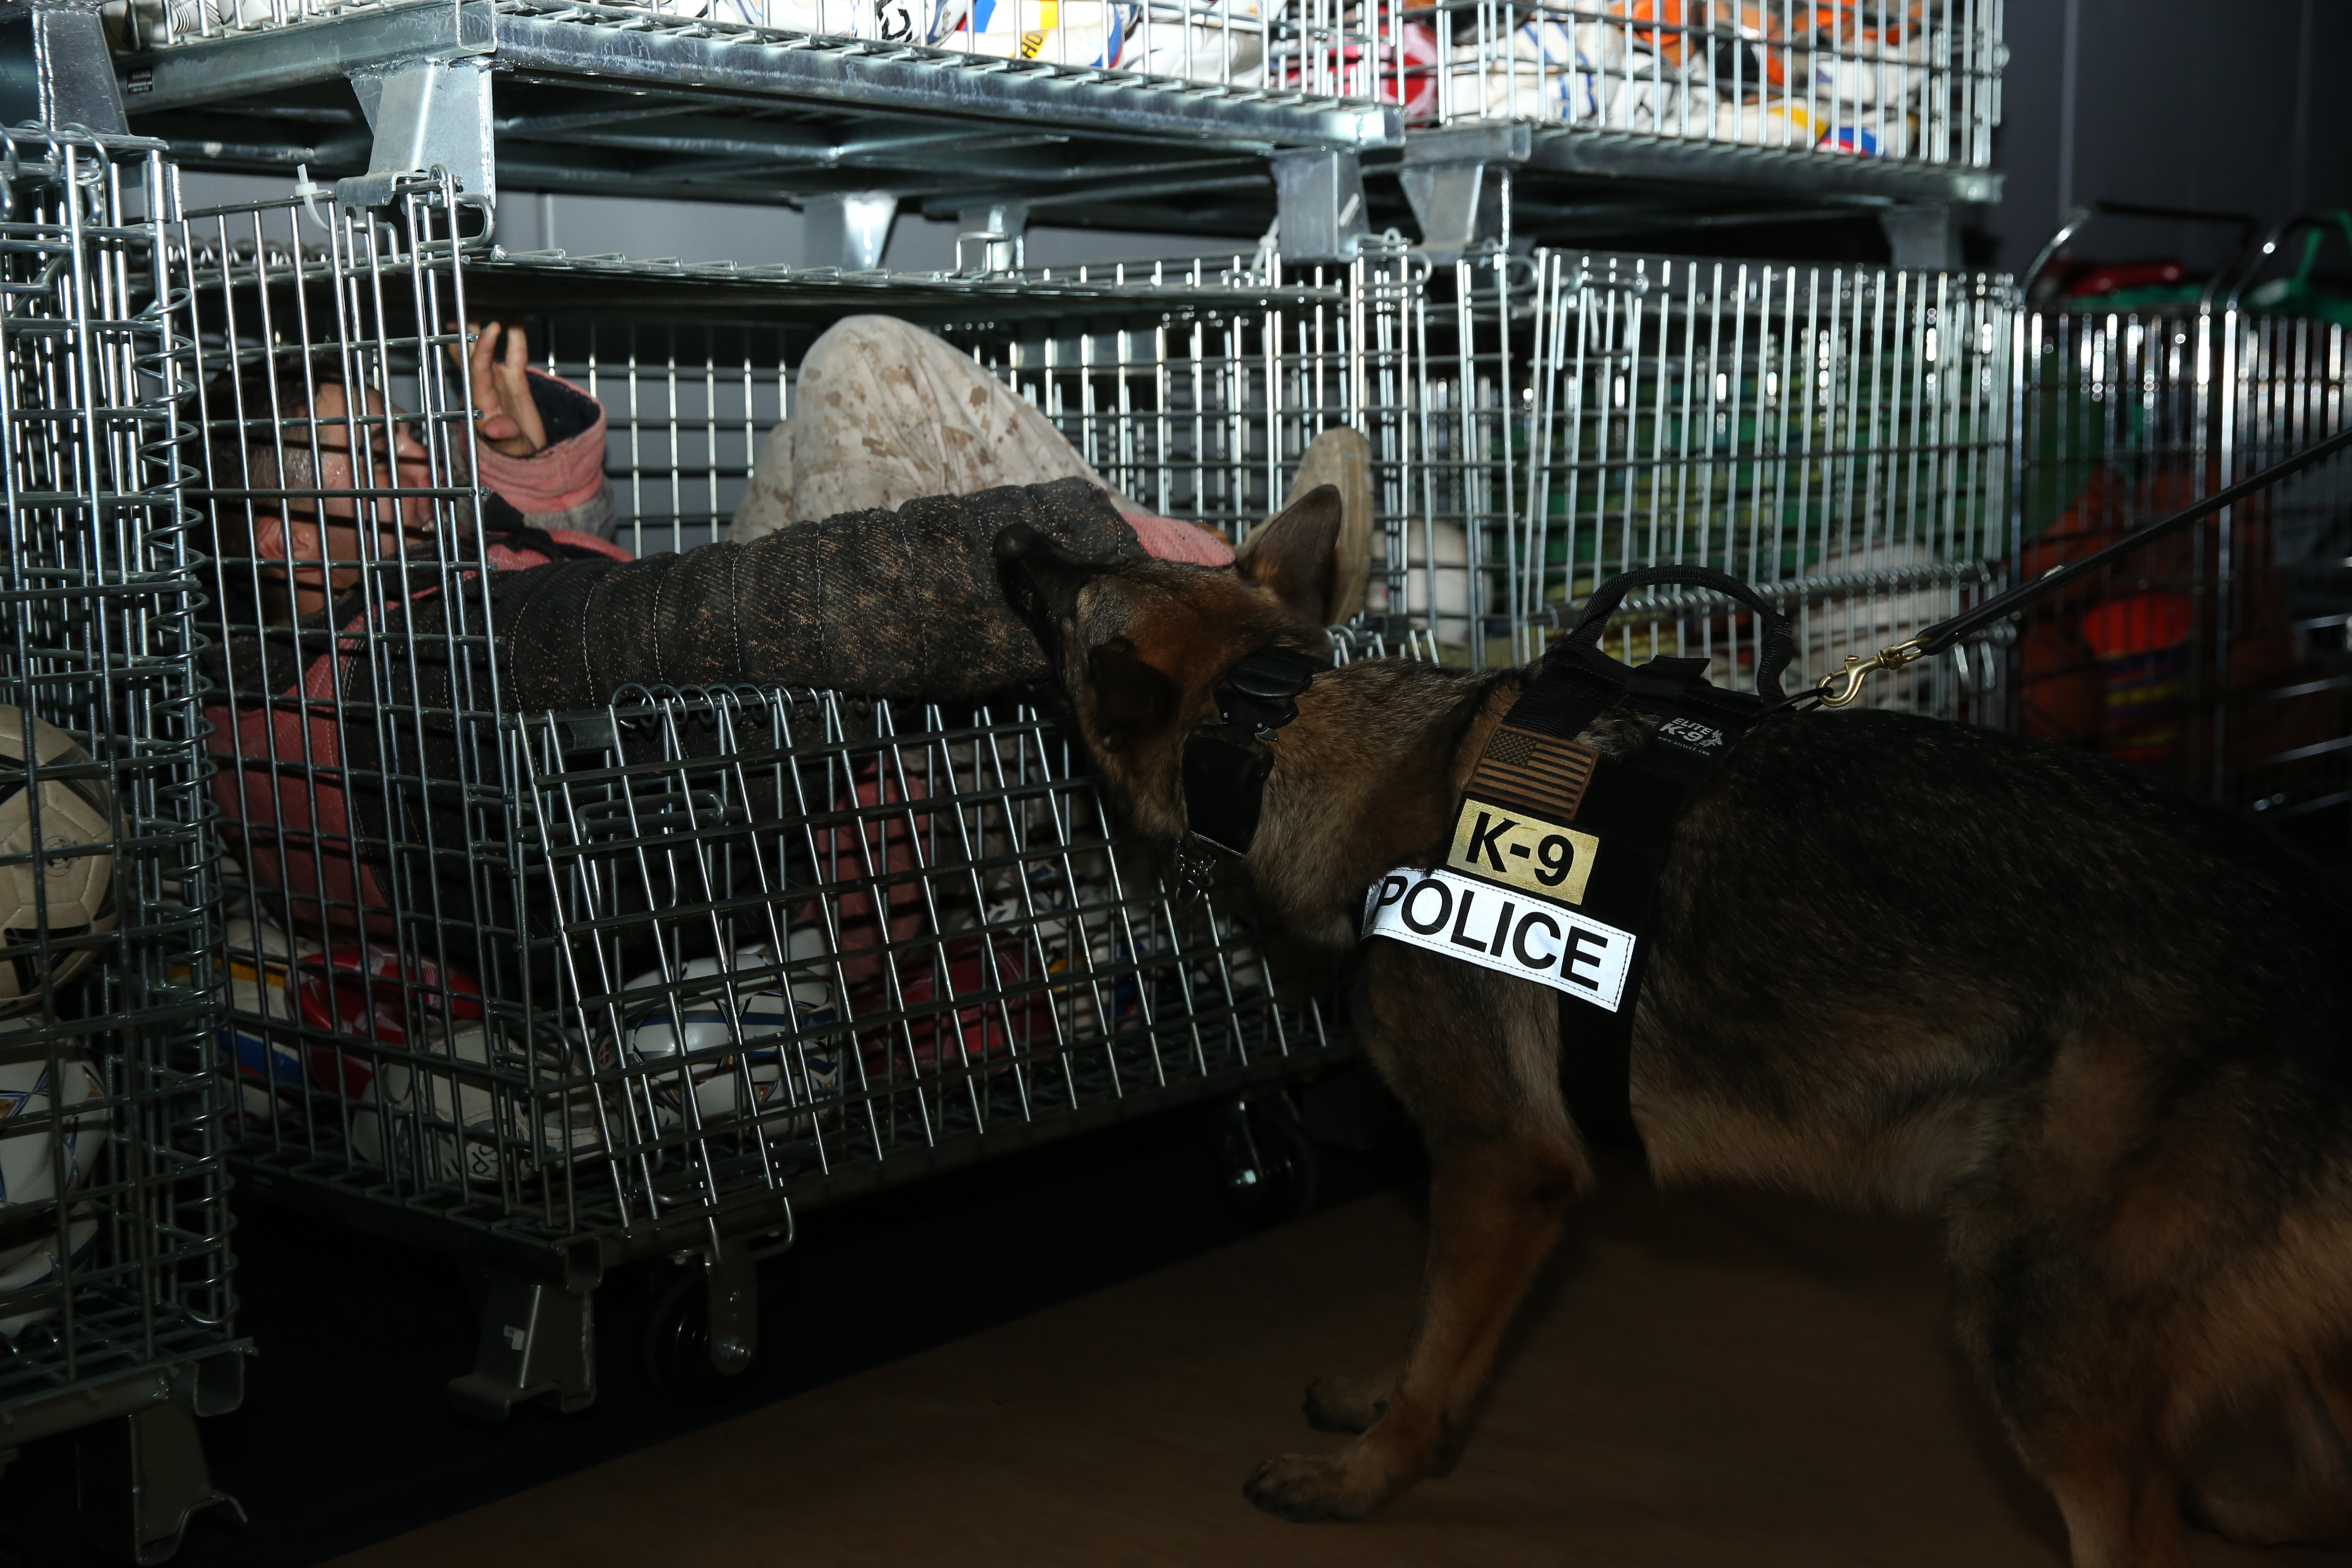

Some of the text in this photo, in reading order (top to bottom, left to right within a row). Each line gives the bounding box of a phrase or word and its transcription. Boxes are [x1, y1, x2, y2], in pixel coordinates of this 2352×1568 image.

[1659, 723, 1704, 741] K-9
[1672, 718, 1713, 735] ELITE
[1465, 811, 1574, 886] K-9
[1369, 875, 1608, 991] POLICE
